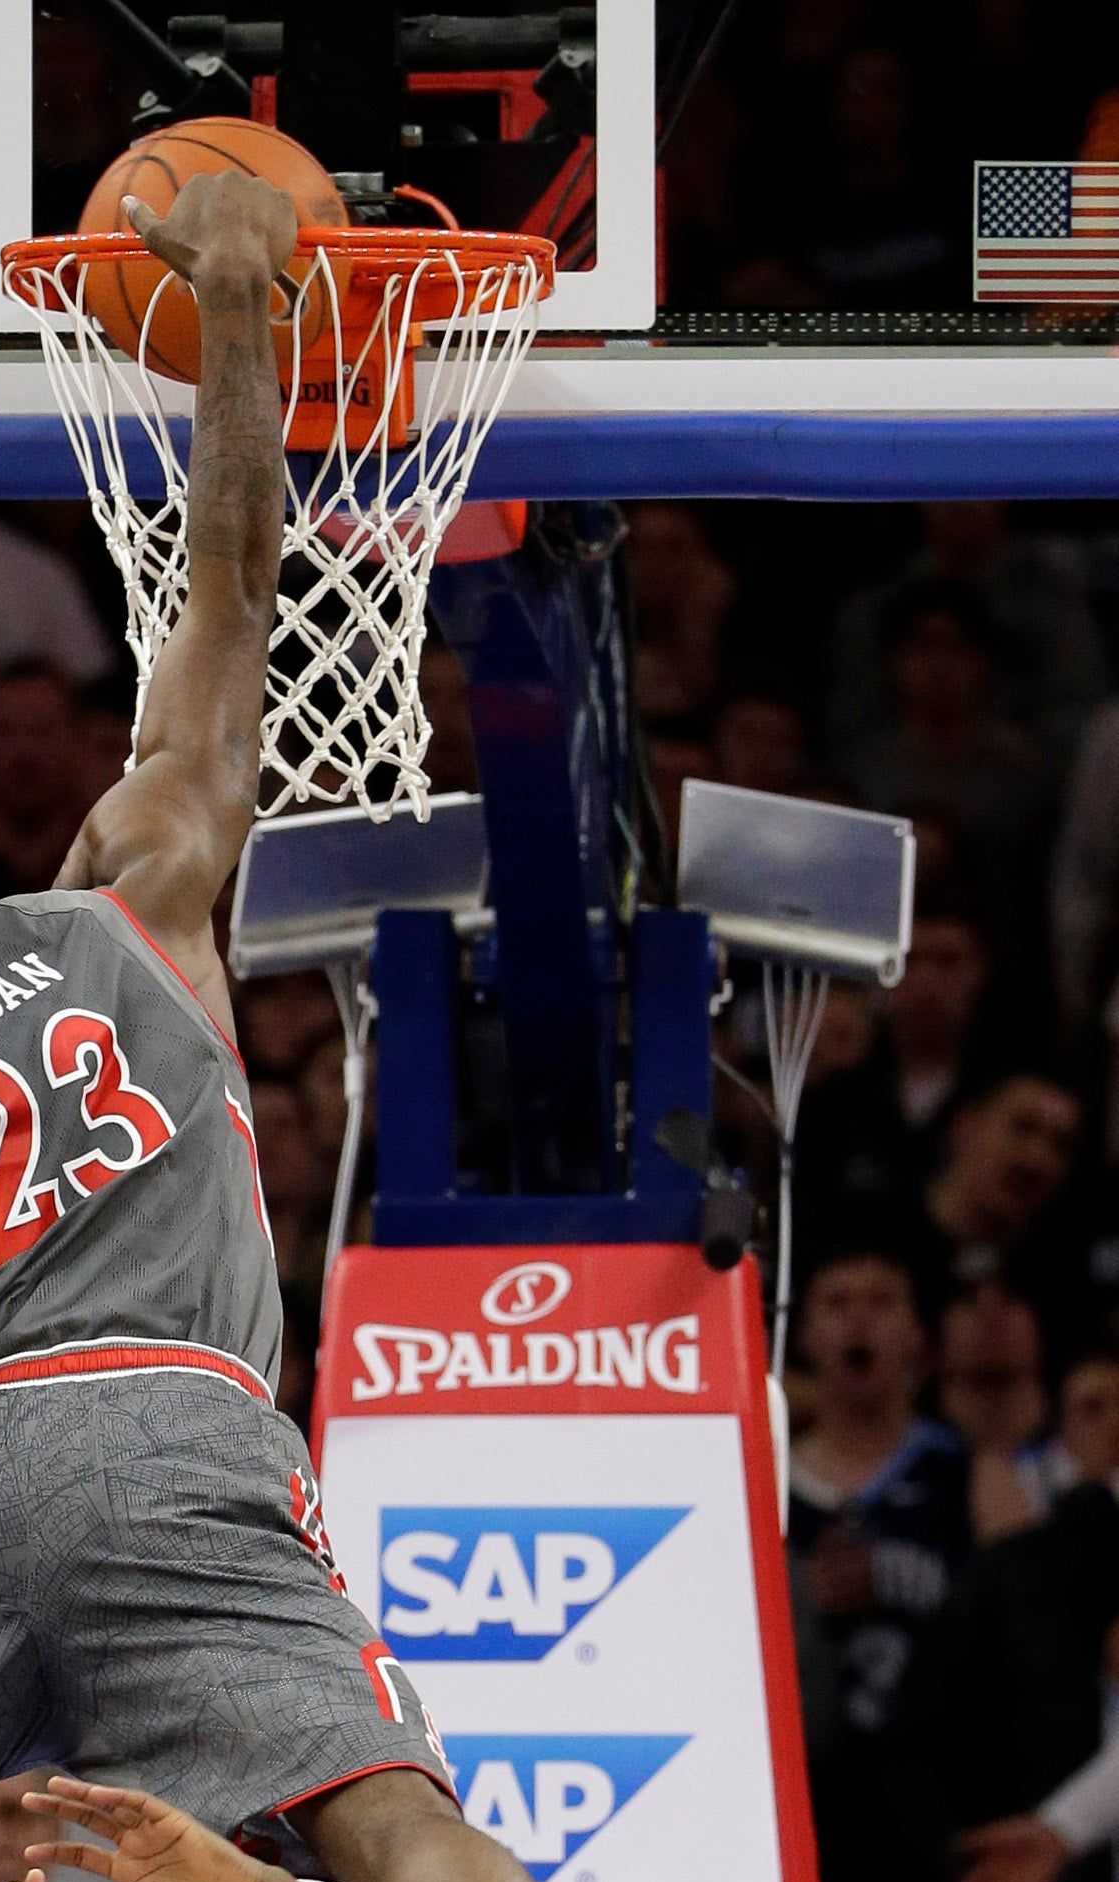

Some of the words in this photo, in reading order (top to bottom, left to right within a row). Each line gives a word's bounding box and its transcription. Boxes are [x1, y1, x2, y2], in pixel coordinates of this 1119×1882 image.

[352, 1314, 701, 1401] SPALDING
[383, 1531, 615, 1636] SAP
[451, 1759, 614, 1863] AP
